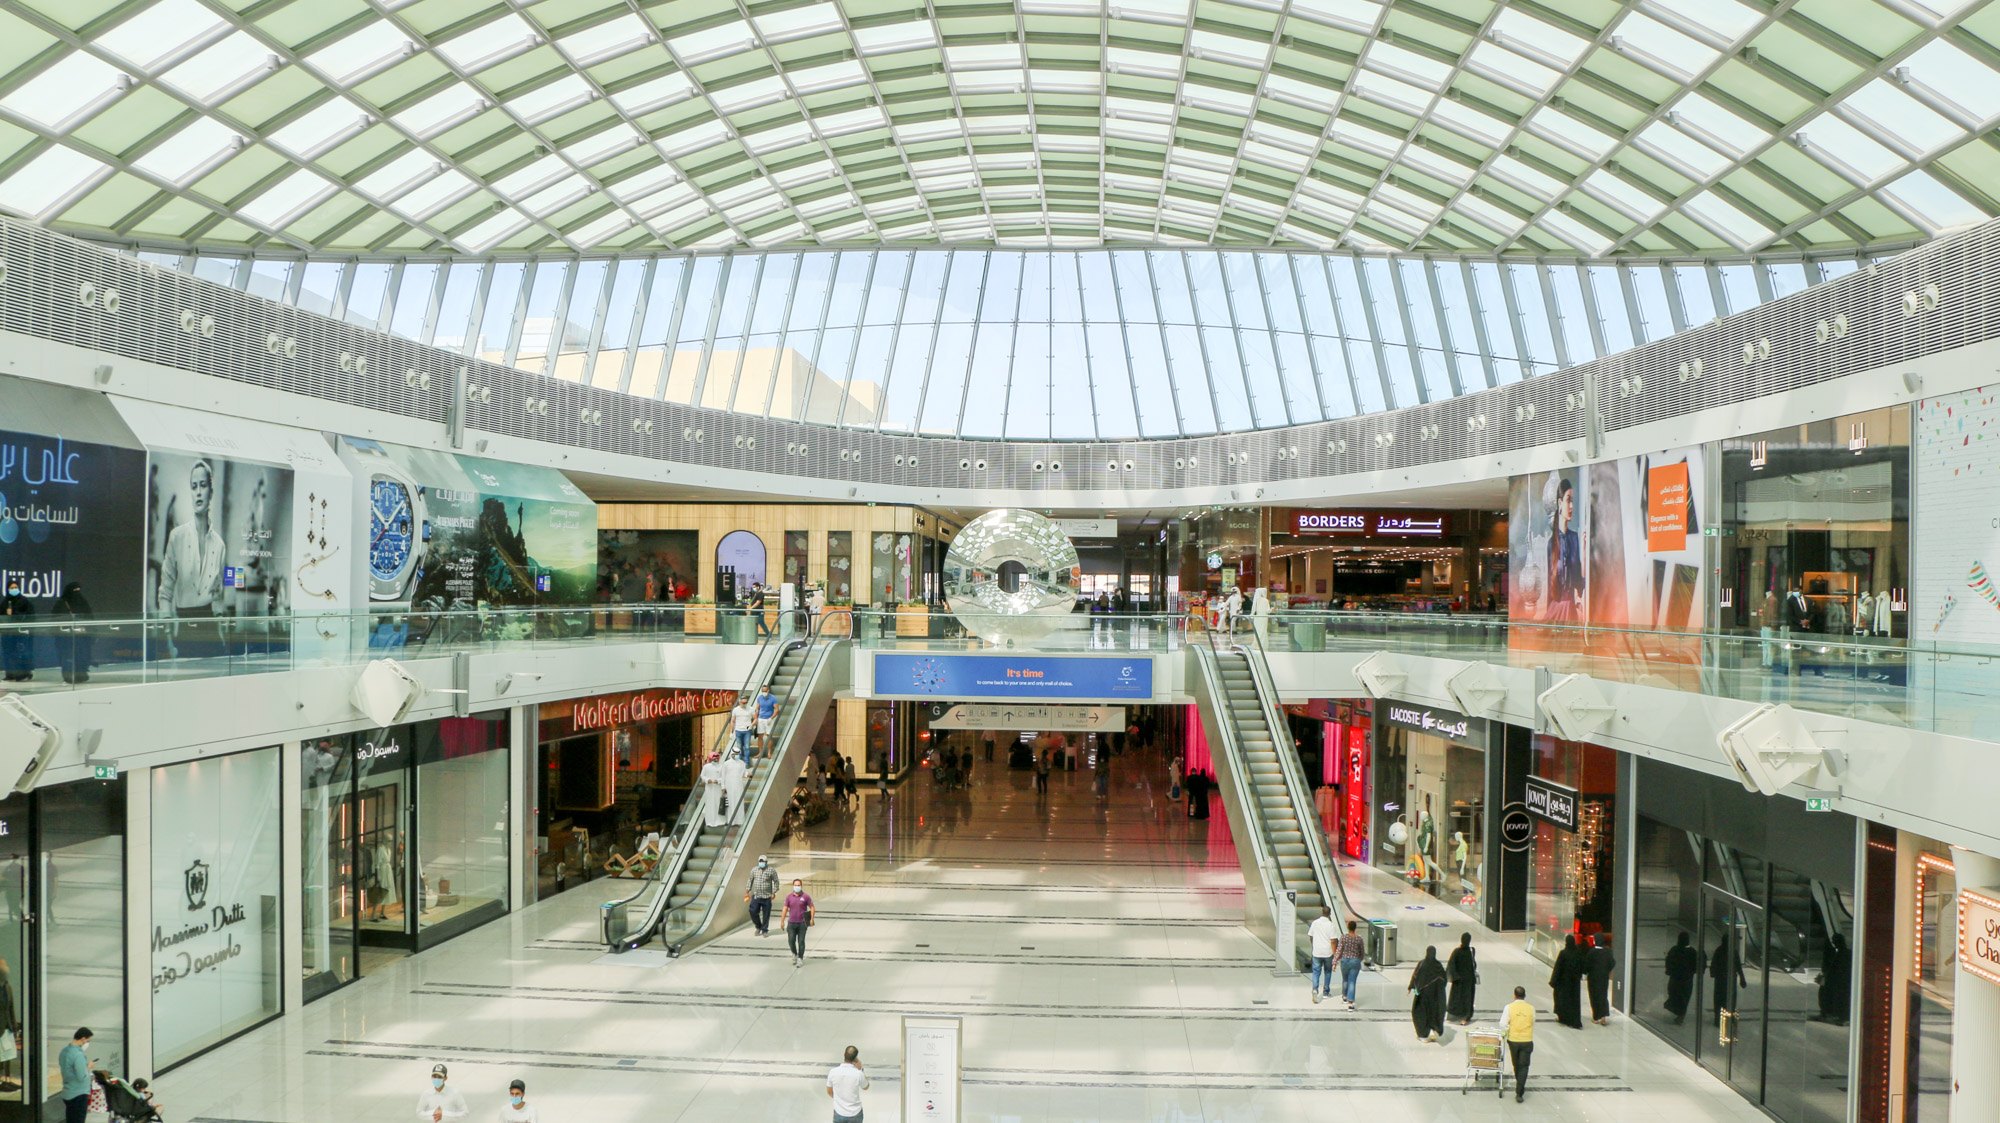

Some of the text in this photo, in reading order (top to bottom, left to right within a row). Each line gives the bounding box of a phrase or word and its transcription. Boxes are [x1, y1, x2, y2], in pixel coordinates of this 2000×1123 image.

[23, 434, 80, 494] علي
[15, 503, 78, 524] للساعات
[402, 503, 407, 516] 2
[550, 506, 567, 518] Coming
[1299, 515, 1364, 528] BORDERS
[395, 552, 400, 565] 5
[1006, 668, 1044, 678] It's time
[573, 699, 629, 731] Molten
[631, 689, 700, 721] Chocolate
[932, 705, 941, 716] G
[1390, 707, 1420, 725] LACOSTE
[1528, 789, 1547, 807] JOVOY
[1506, 823, 1528, 831] JOVOY
[151, 903, 246, 952] Massimo Dutti
